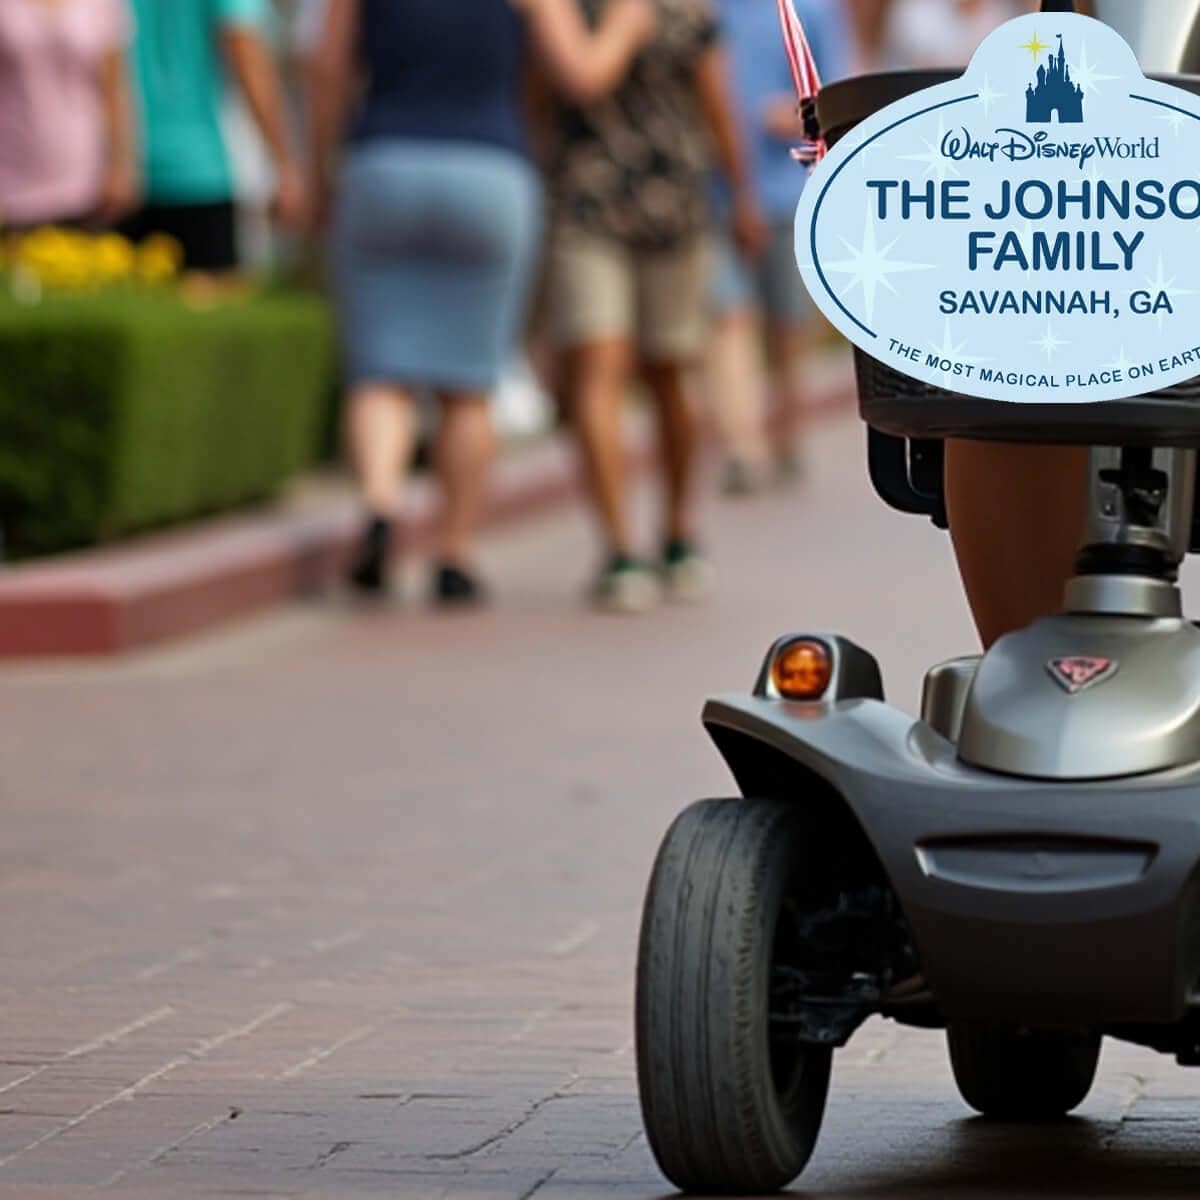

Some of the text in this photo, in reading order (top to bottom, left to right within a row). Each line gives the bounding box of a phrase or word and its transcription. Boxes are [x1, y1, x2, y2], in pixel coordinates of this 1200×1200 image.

[865, 179, 972, 221] THE
[967, 230, 1145, 272] FAMILY
[939, 290, 1174, 319] SAVANNAH, GA
[888, 337, 922, 363] THE
[925, 352, 976, 379] MOST
[979, 367, 1061, 389] MAGICAL
[1064, 365, 1124, 388] PLACE
[1126, 362, 1155, 381] ON
